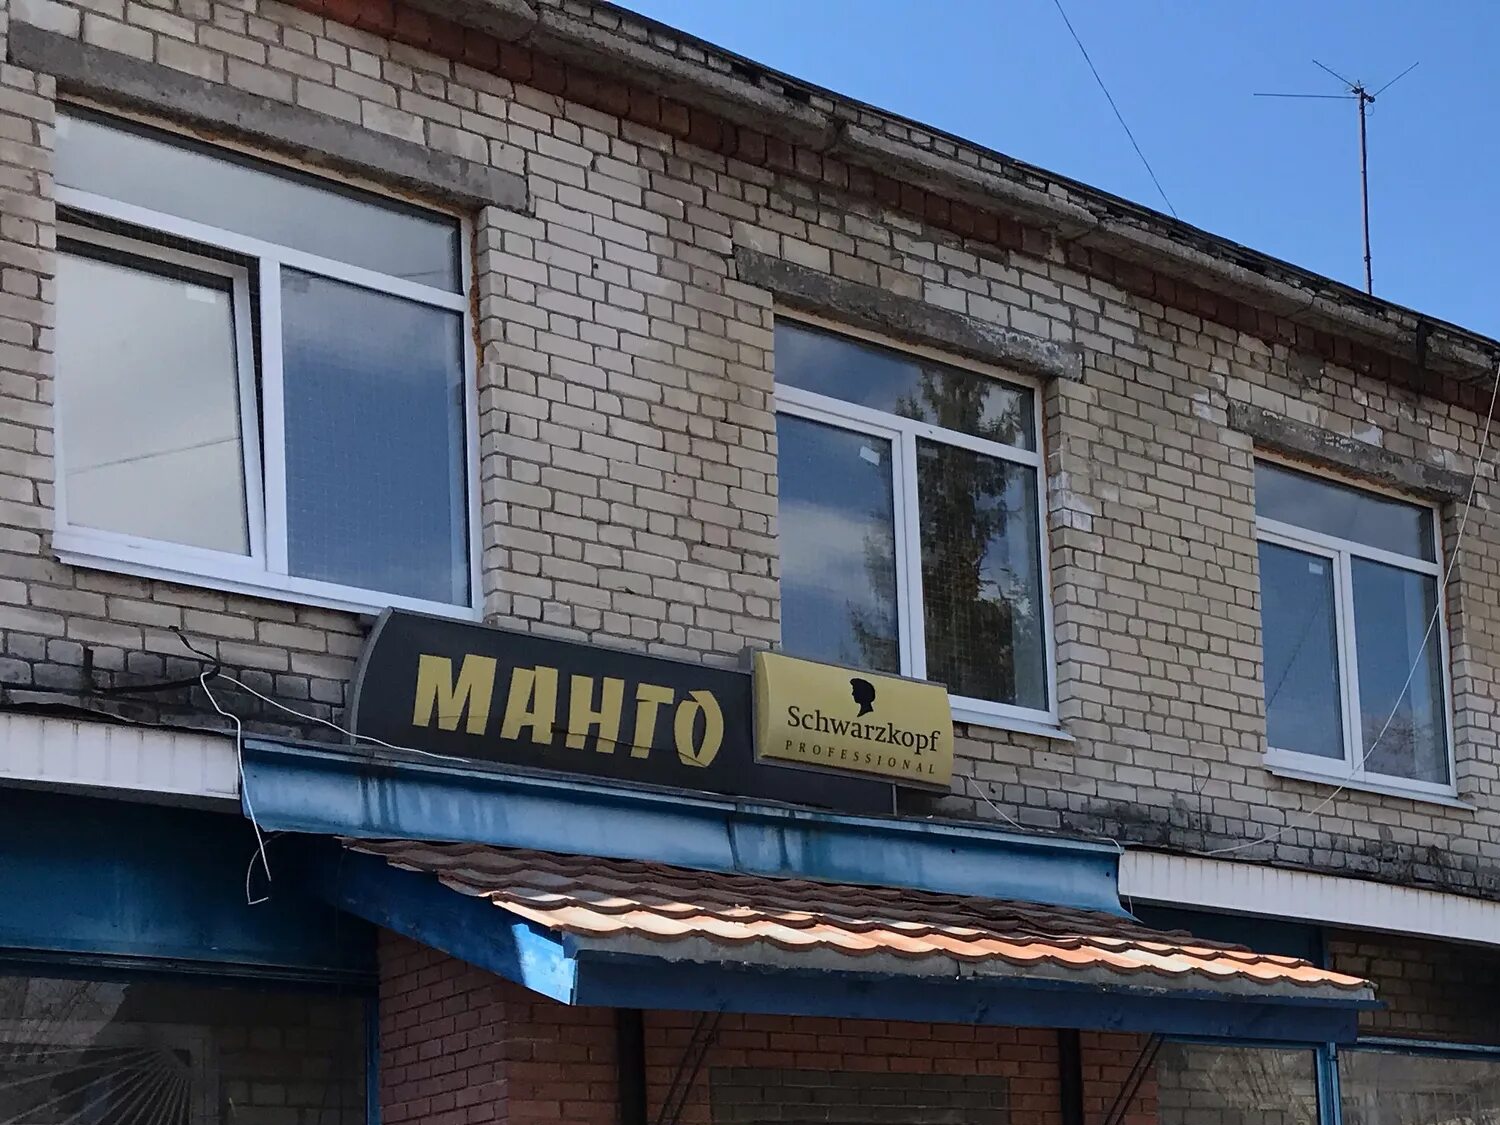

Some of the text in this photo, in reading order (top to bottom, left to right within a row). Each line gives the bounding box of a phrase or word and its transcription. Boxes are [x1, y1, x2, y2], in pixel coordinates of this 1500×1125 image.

[413, 653, 724, 768] МАНГО
[787, 705, 942, 756] Schwarzkopf
[785, 739, 936, 775] PROFESSIONAL
